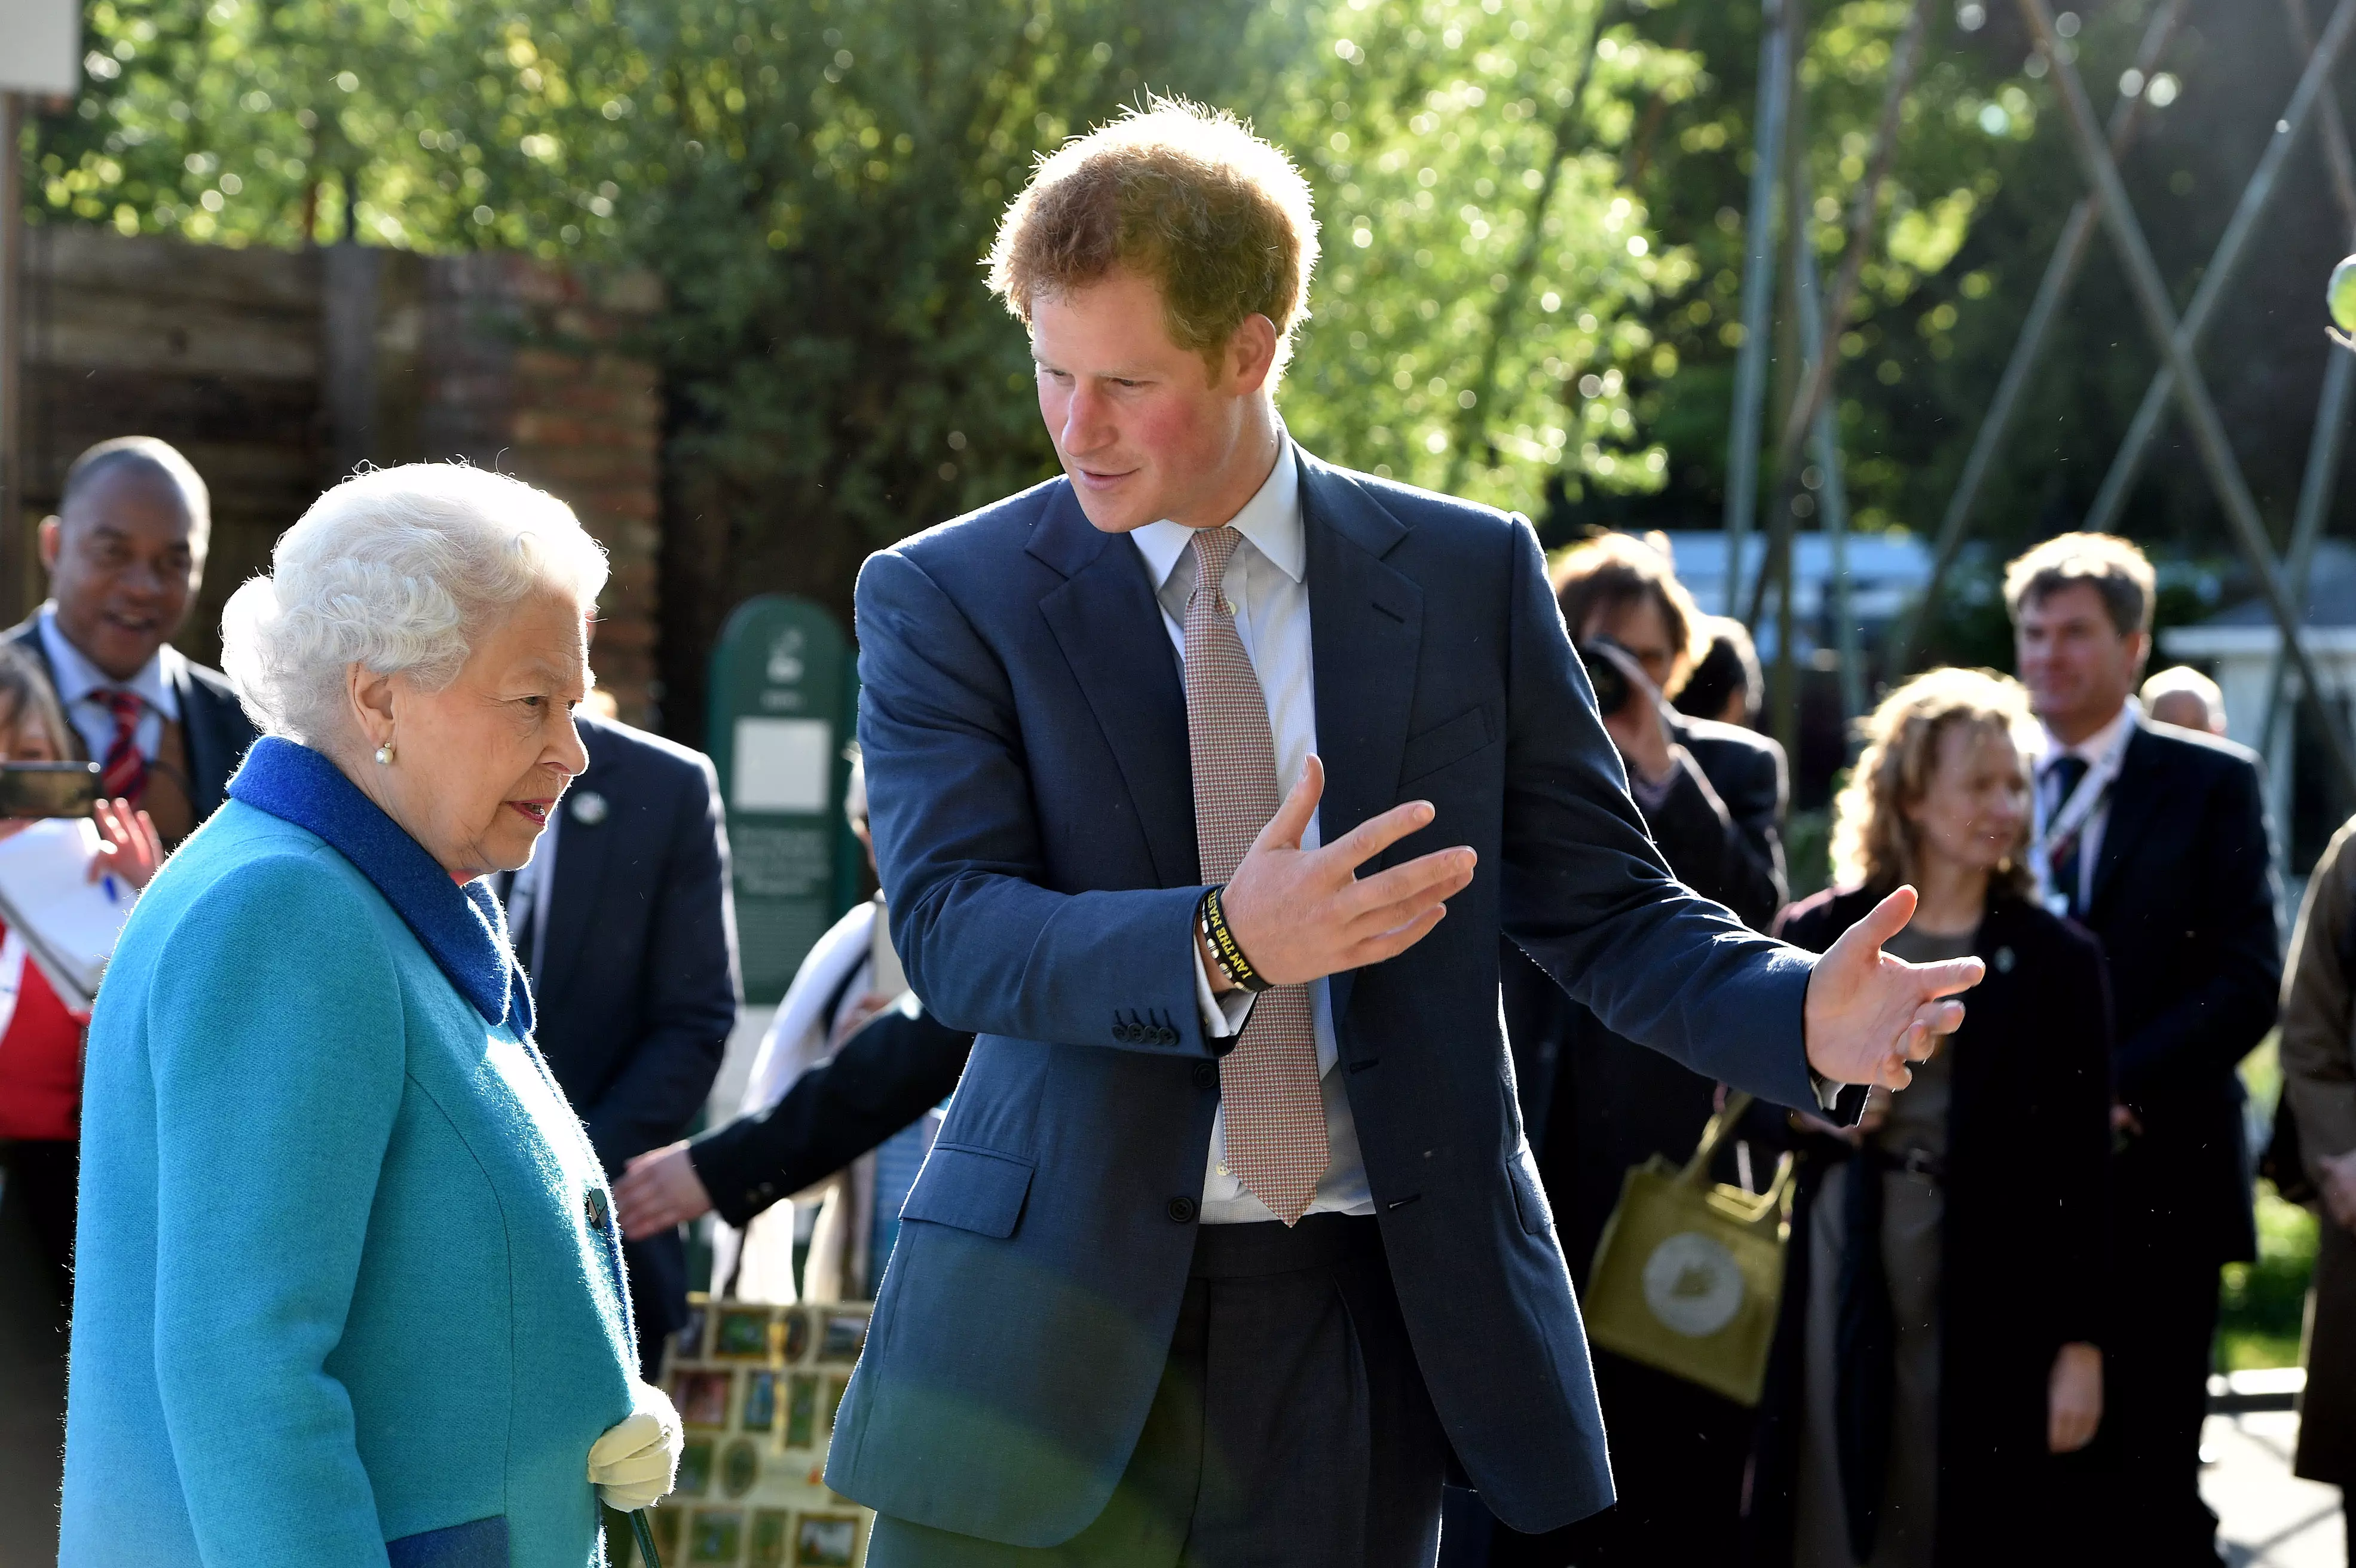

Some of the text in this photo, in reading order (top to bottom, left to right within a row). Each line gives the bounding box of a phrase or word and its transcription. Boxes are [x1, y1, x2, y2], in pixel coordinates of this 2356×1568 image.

[1216, 927, 1235, 955] THE
[1229, 952, 1249, 972] AM
[1241, 970, 1253, 979] I
